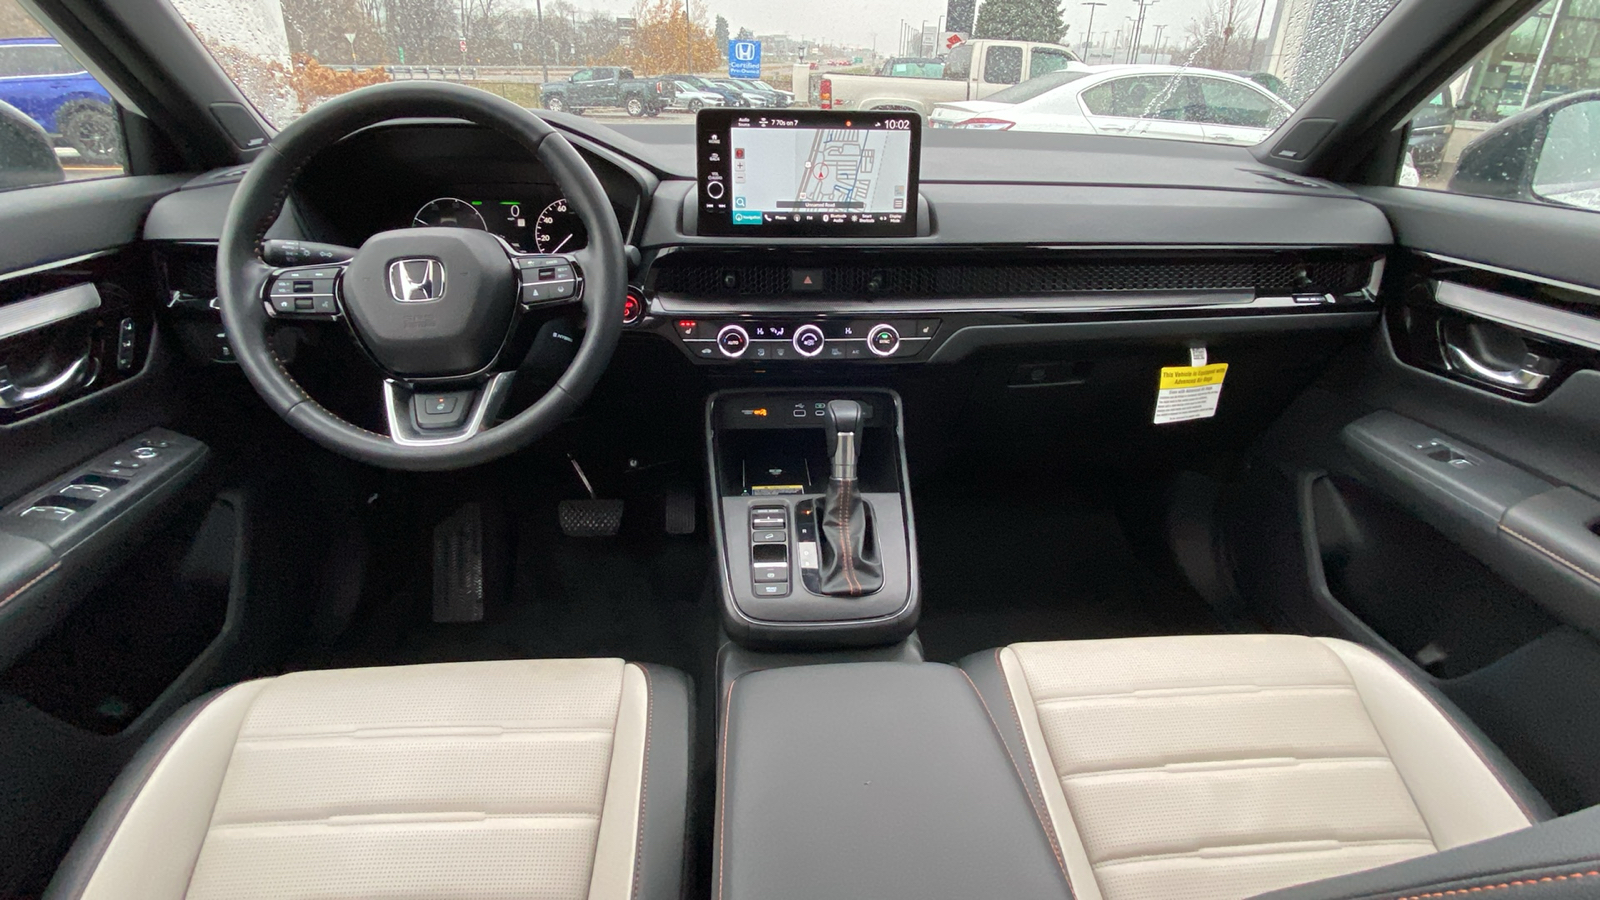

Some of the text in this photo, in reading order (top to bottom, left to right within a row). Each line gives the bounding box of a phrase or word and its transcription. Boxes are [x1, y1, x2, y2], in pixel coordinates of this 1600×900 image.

[884, 119, 910, 129] 10:02
[510, 204, 520, 217] 0
[541, 234, 550, 242] 20
